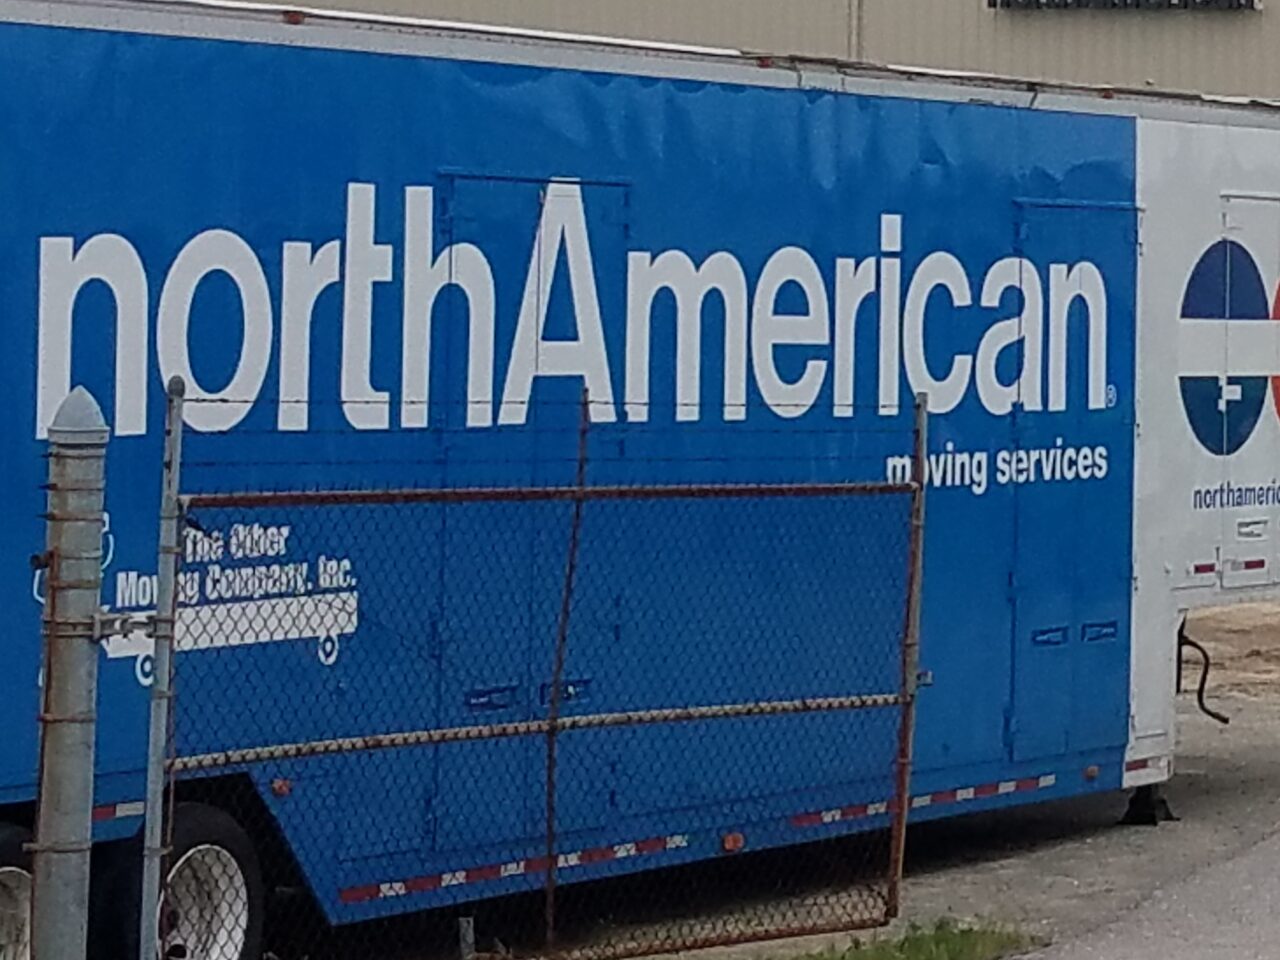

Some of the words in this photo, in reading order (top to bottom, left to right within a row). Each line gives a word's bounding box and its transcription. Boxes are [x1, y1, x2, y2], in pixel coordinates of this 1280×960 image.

[886, 440, 988, 496] mving
[996, 437, 1108, 485] services
[182, 526, 224, 563] The
[230, 522, 290, 560] Other
[116, 570, 200, 606] Mog
